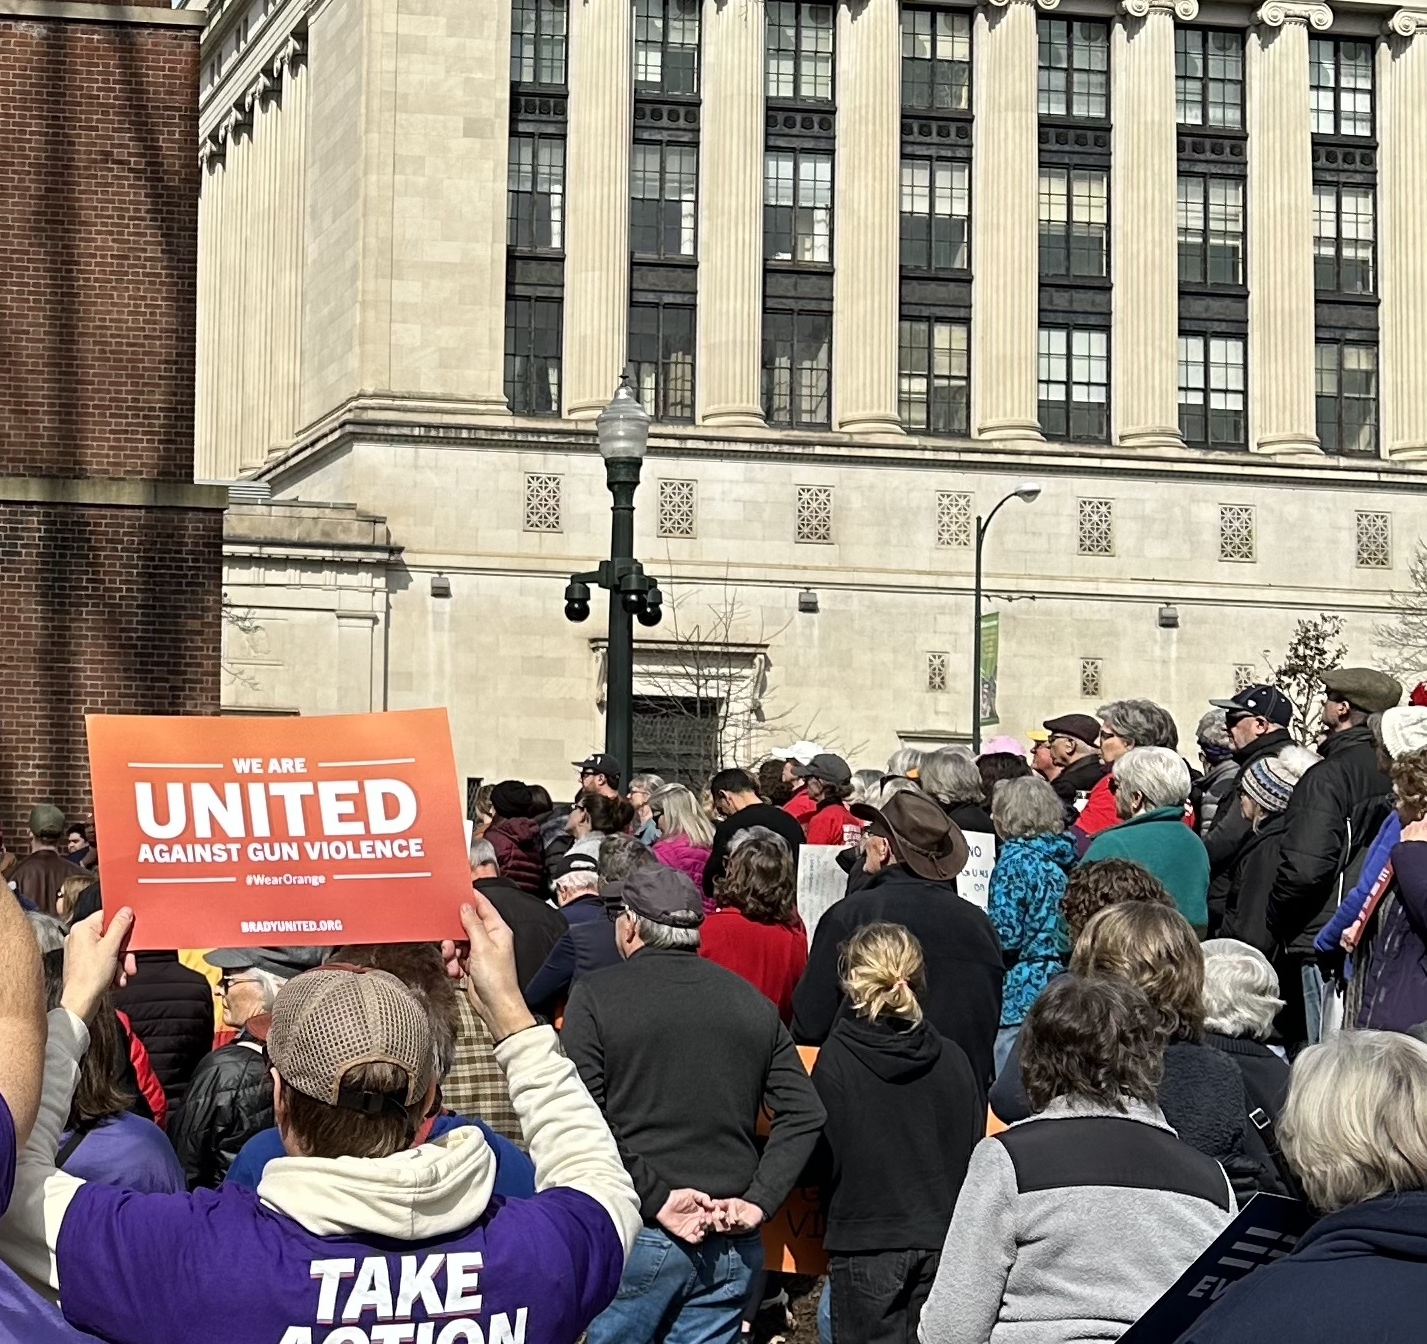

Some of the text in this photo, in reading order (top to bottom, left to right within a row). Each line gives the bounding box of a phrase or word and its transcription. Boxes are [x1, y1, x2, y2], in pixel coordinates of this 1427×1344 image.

[232, 757, 307, 774] WE ARE
[135, 778, 418, 839] UNITED
[138, 838, 424, 863] AGAINST GUN VIOLENCE
[245, 874, 326, 887] #WearOrange
[241, 920, 343, 933] BRADYUNITED.ORG
[310, 1252, 484, 1324] TAKE
